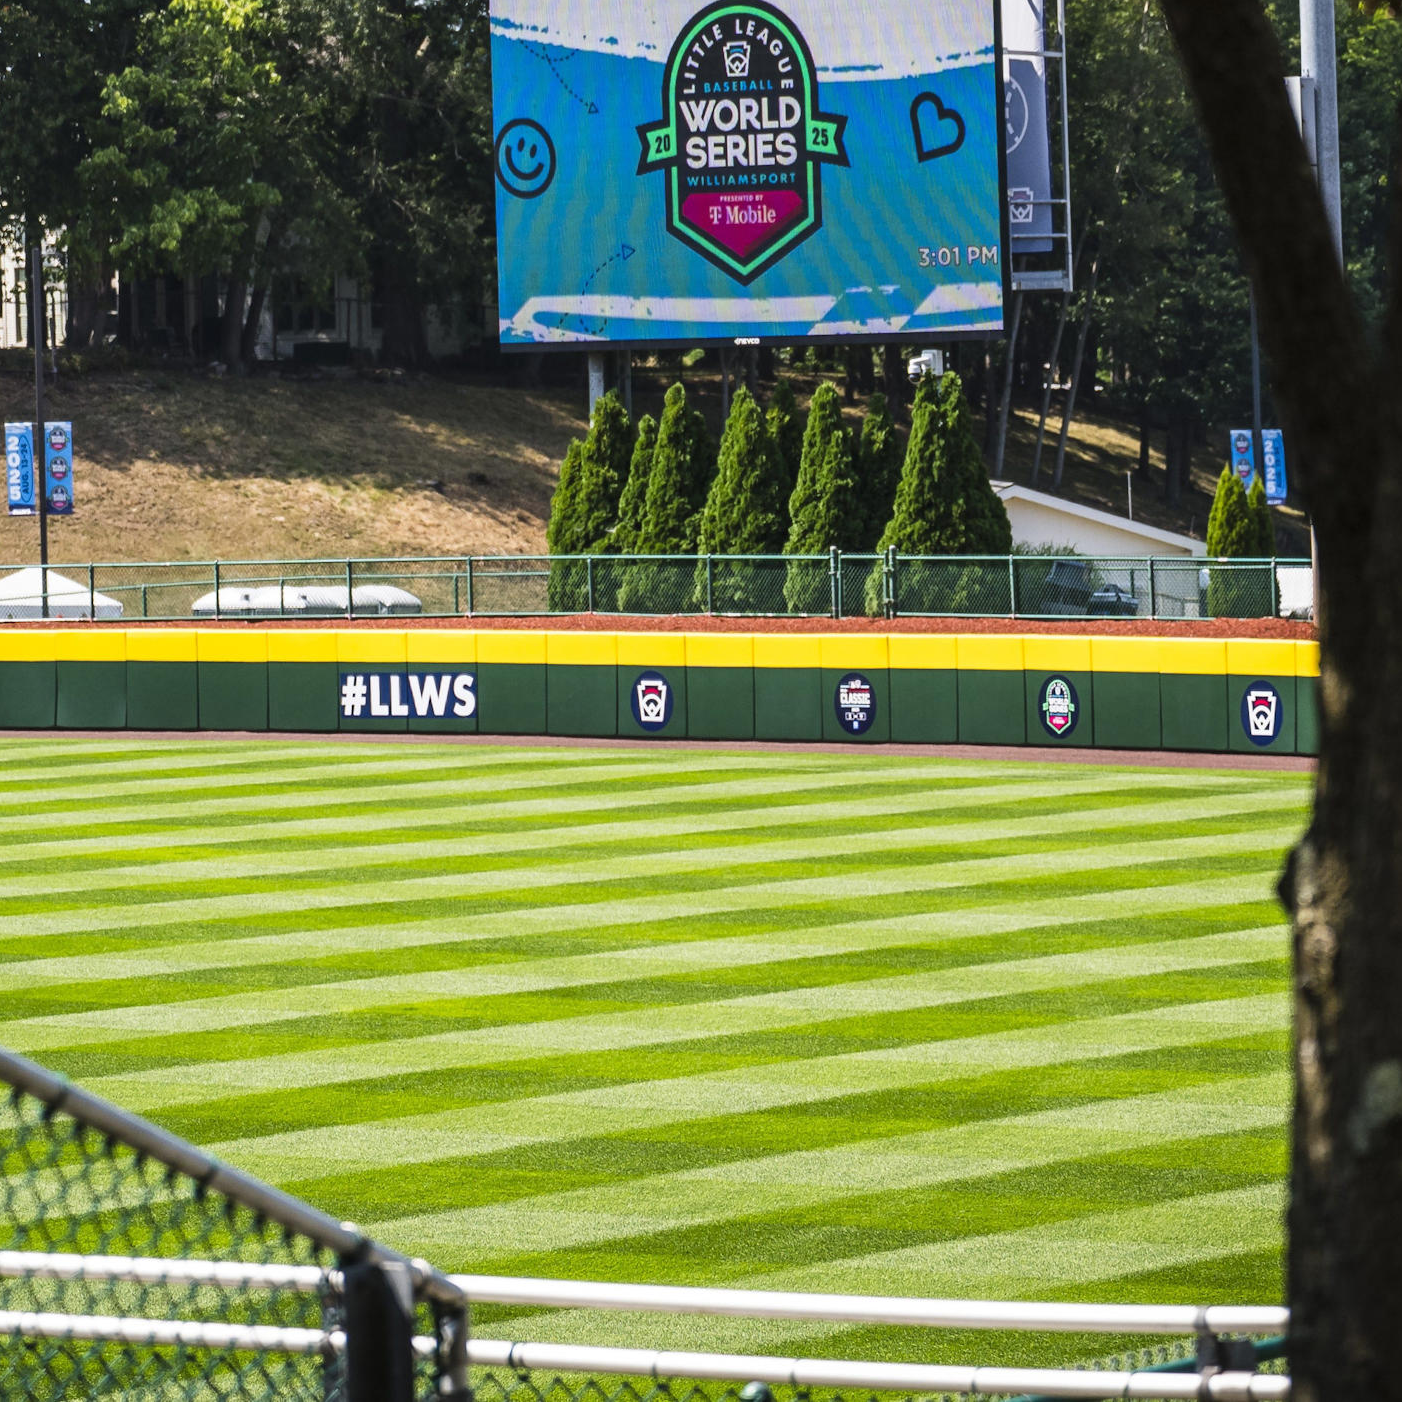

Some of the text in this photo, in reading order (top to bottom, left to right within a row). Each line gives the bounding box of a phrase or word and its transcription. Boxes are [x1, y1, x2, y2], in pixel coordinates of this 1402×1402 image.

[683, 18, 794, 95] LITTLE LEAGUE
[703, 79, 774, 94] BASEBALL
[679, 96, 802, 133] WORLD
[655, 133, 671, 154] 20
[685, 132, 798, 170] SERIES
[811, 127, 829, 147] 25
[687, 172, 796, 187] WILLIAMSPORT
[918, 245, 998, 267] 3:01 PM
[7, 436, 22, 501] 2025
[341, 674, 476, 717] #LLWS
